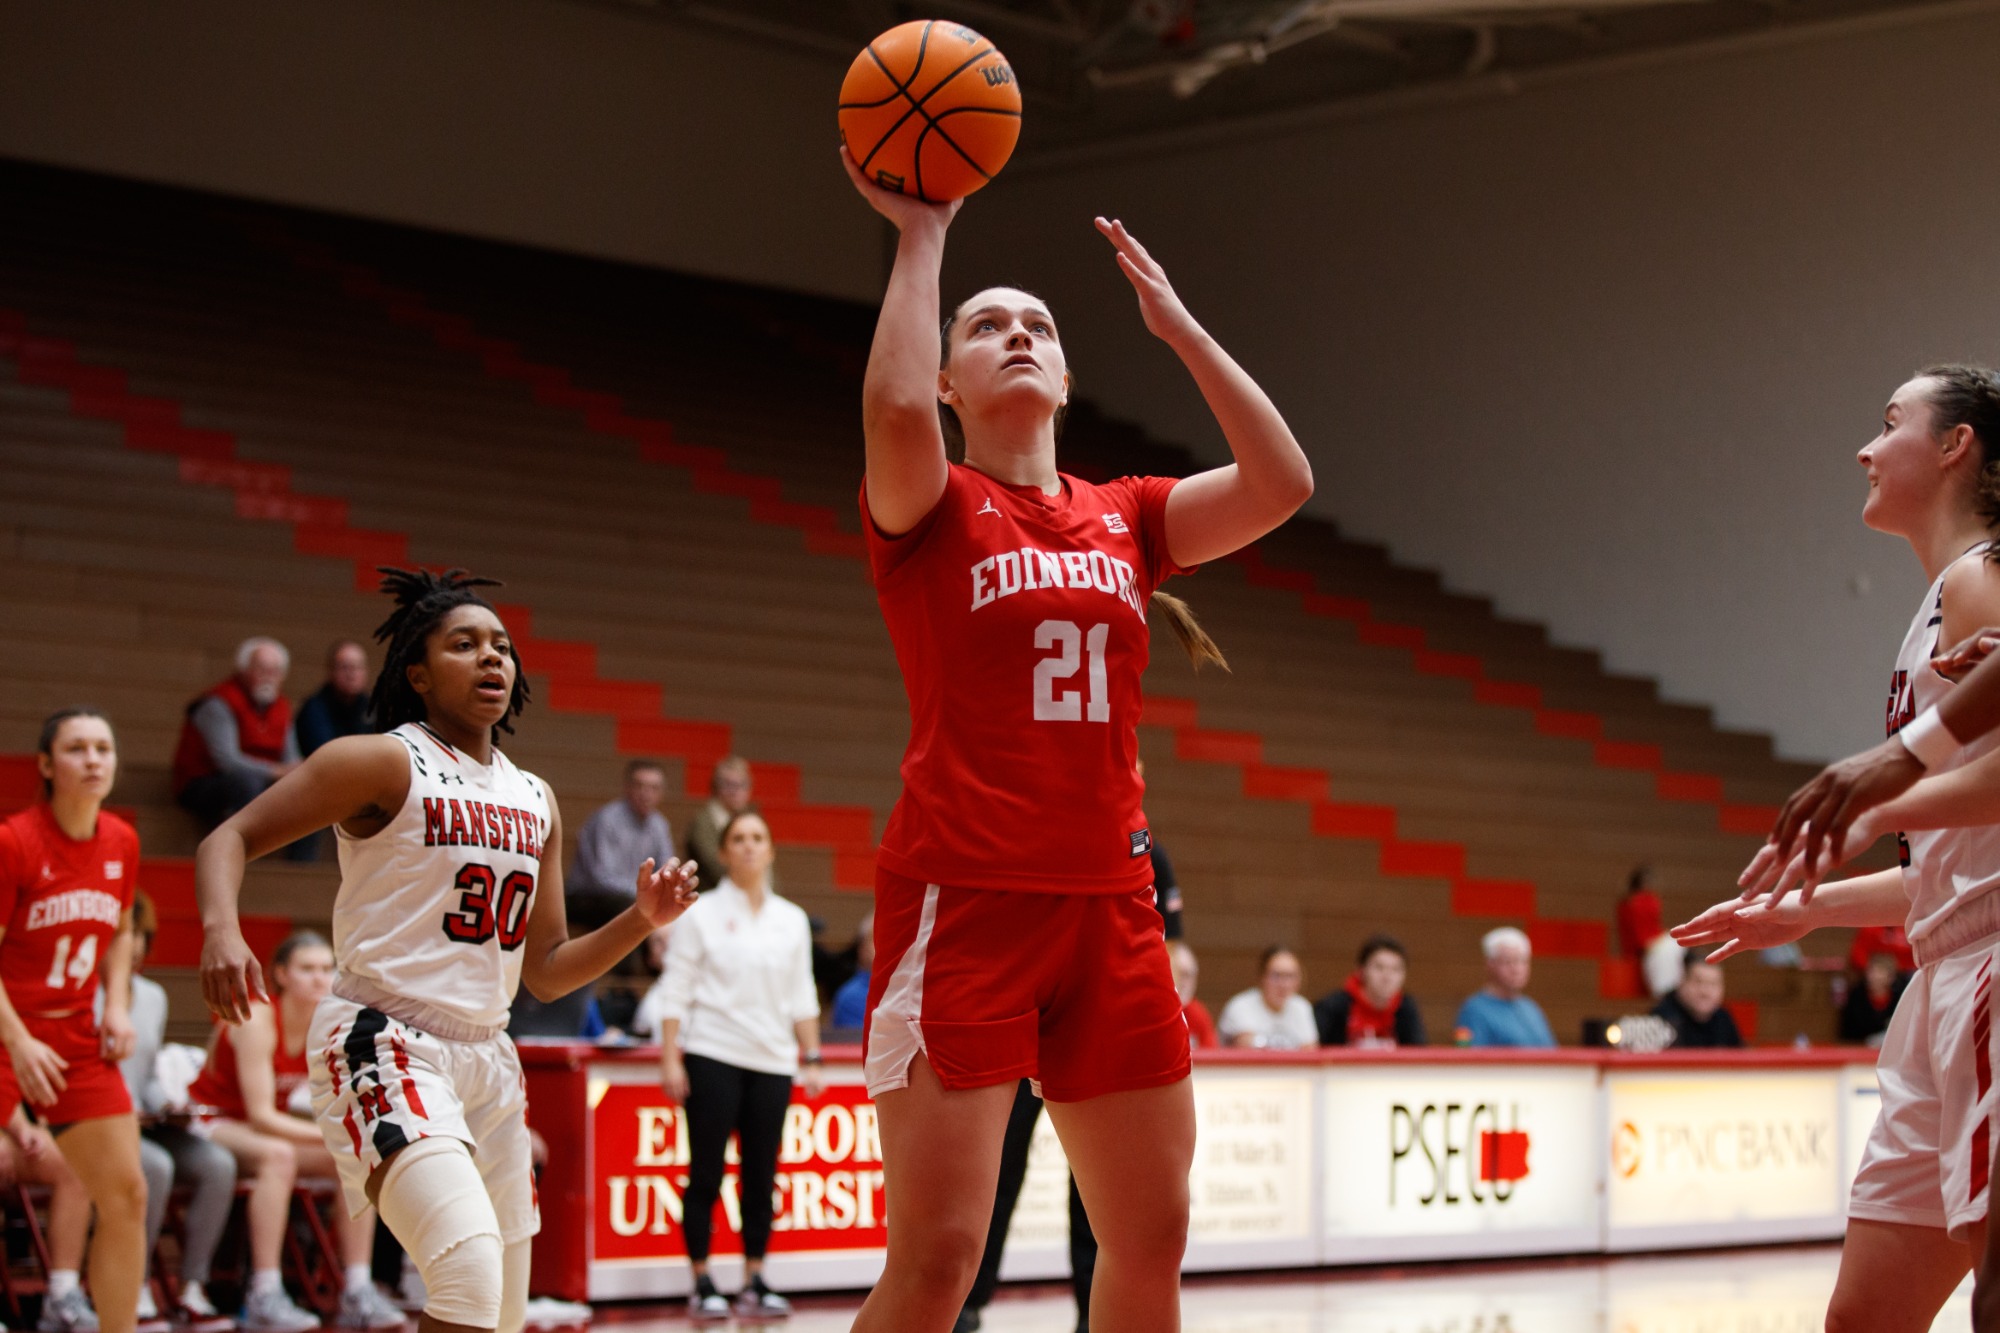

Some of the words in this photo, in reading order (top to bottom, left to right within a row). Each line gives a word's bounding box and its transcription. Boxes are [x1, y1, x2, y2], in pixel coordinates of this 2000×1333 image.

[1033, 619, 1110, 723] 21
[423, 797, 545, 862] MANSFIEL
[26, 888, 122, 931] EDINBOR
[442, 863, 534, 952] 30
[45, 933, 99, 990] 14
[357, 1083, 394, 1127] M
